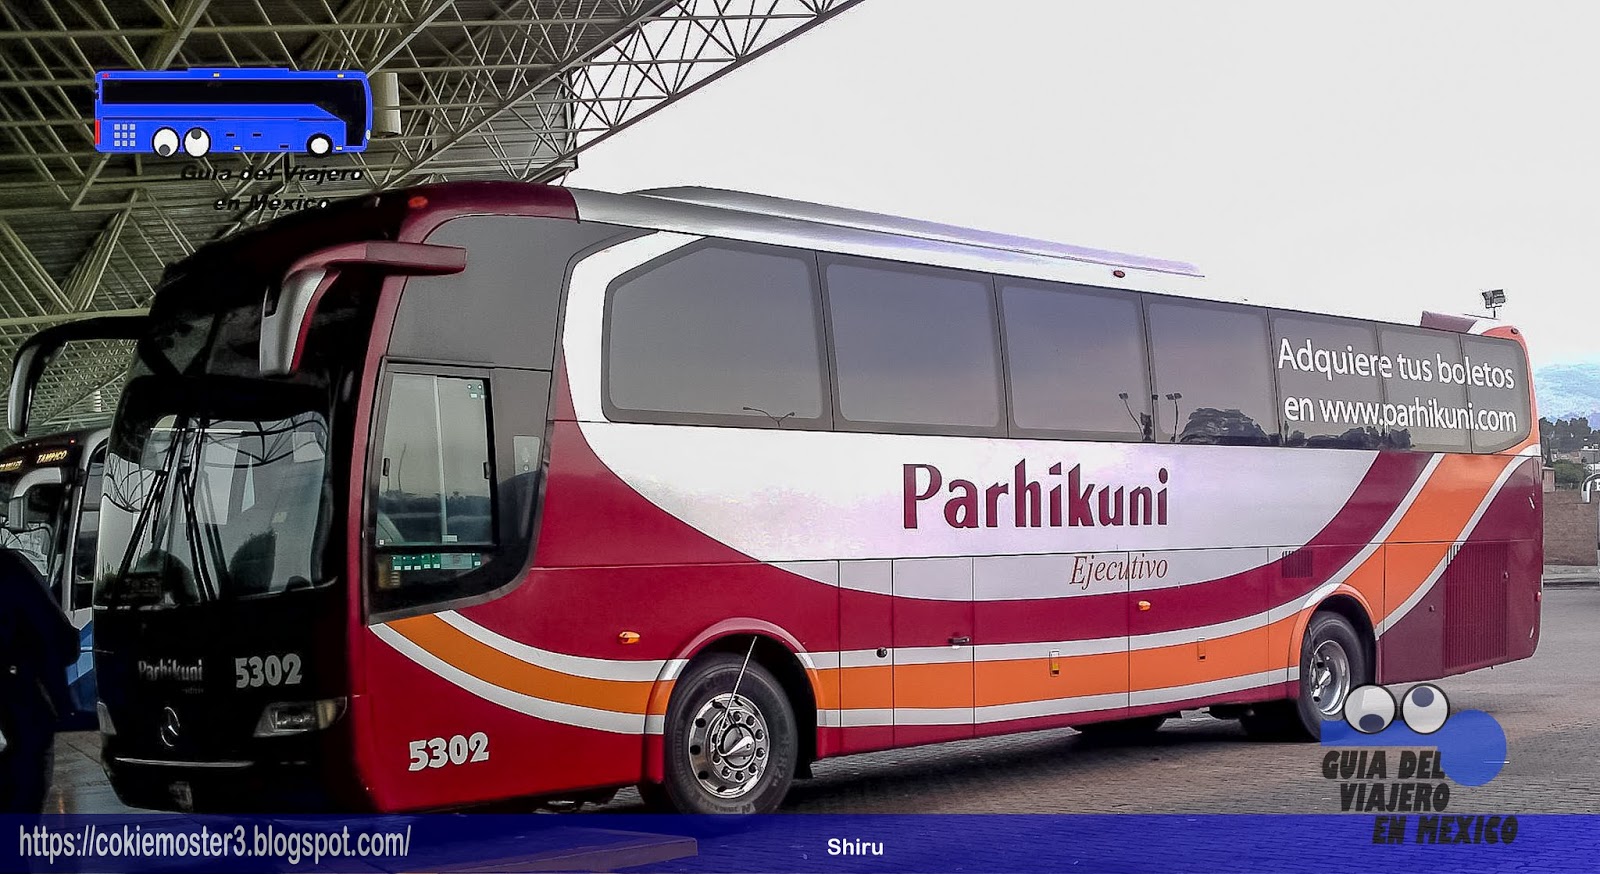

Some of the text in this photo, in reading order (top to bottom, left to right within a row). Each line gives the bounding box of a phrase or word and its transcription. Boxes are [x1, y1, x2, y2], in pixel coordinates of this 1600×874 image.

[1278, 338, 1515, 389] Adquiere tus boletos
[1284, 396, 1517, 433] en www.parhikuni.com
[36, 450, 68, 464] TAMPICO
[903, 458, 1169, 529] Parhikuni
[1069, 552, 1169, 590] Ejecutivo
[137, 659, 203, 682] Parhikuni
[234, 653, 303, 688] 5302
[408, 732, 490, 771] 5302
